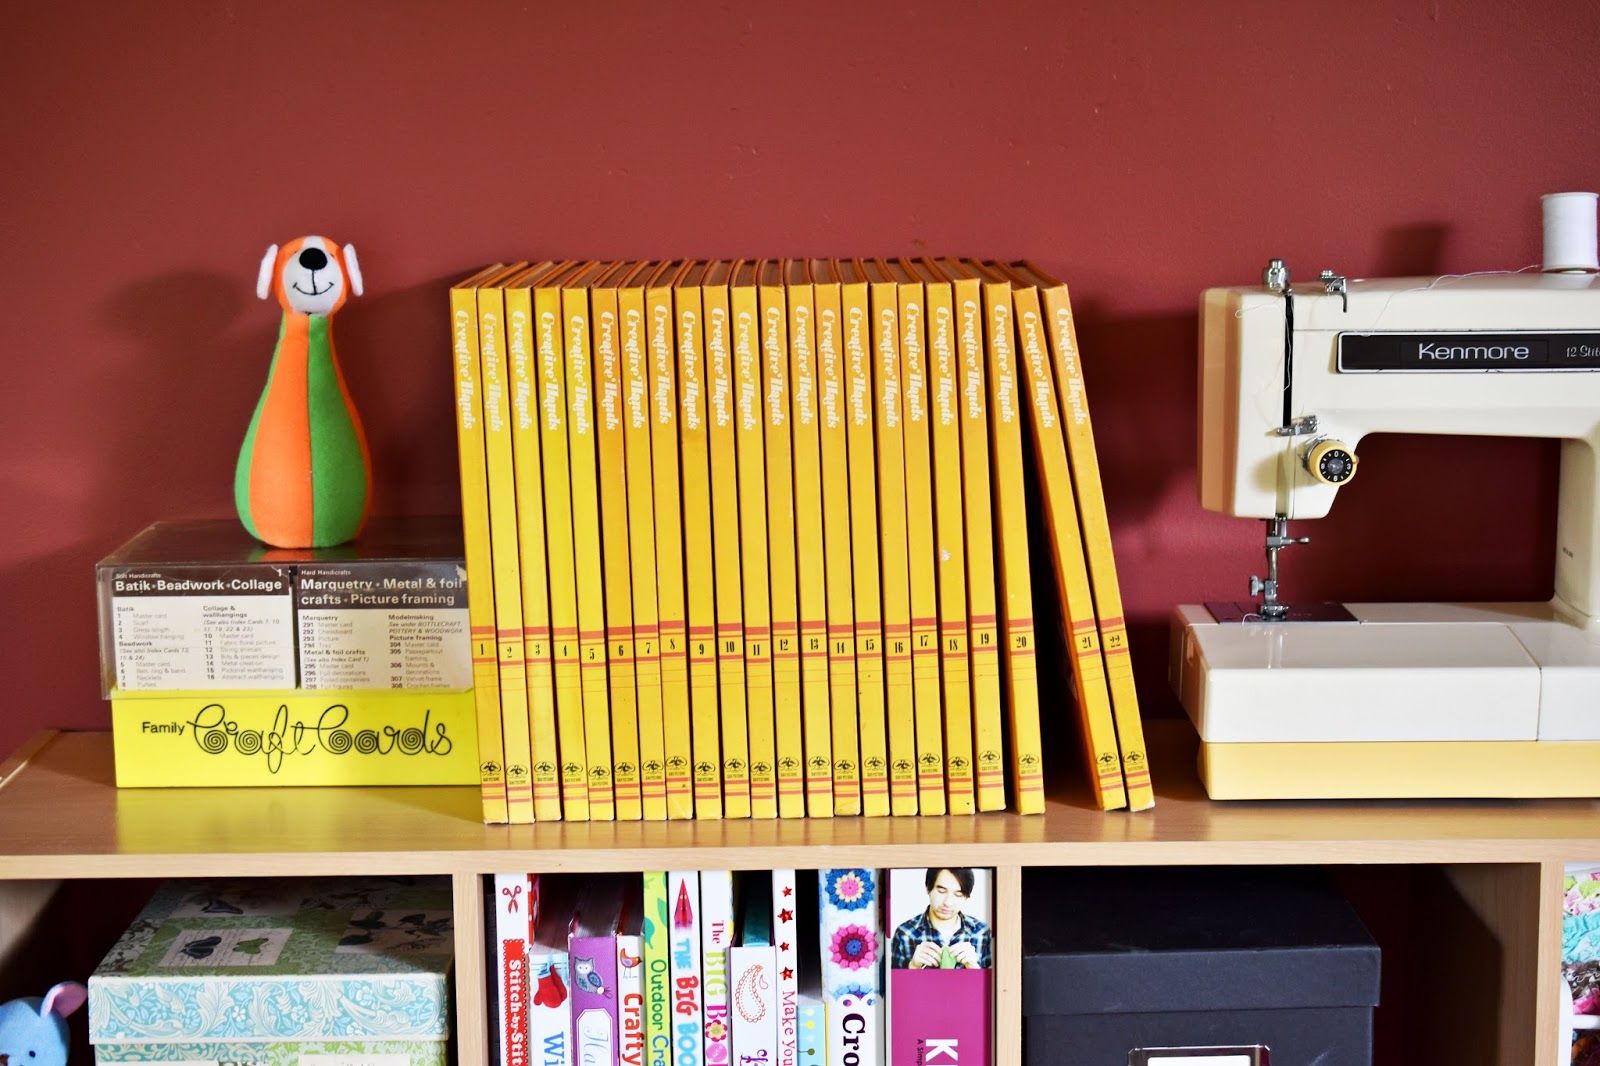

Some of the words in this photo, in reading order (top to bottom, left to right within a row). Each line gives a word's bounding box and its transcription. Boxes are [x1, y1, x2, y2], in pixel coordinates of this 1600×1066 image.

[1418, 342, 1529, 360] Kenmore
[1566, 346, 1576, 358] 12
[1580, 344, 1600, 357] Stit
[459, 376, 475, 428] Hands
[486, 379, 503, 432] Hands
[515, 376, 532, 429] Hands
[544, 378, 560, 430] Hands
[573, 382, 589, 434] Hands
[602, 378, 618, 430] Hands
[628, 376, 645, 428] Hands
[656, 371, 671, 423] Hands
[684, 377, 700, 429] Hands
[713, 374, 729, 426] Hands
[740, 378, 756, 430] Hands
[768, 374, 784, 424] Hands
[796, 372, 813, 424] Hands
[823, 376, 839, 428] Hands
[851, 374, 867, 424] Hands
[882, 375, 899, 427] Hands
[907, 369, 923, 421] Hands
[937, 373, 954, 424] Hands
[965, 366, 982, 418] Hands
[998, 370, 1014, 422] Hands
[1036, 378, 1054, 428] Hands
[1067, 374, 1086, 424] Hands
[115, 580, 150, 591] Batik
[157, 580, 224, 590] Beadwork
[231, 579, 282, 592] Collage
[301, 579, 372, 592] Marquetry
[383, 578, 422, 589] Metal
[426, 578, 436, 589] &
[440, 578, 462, 589] foil
[301, 594, 341, 605] crafts
[351, 594, 399, 604] Picture
[402, 593, 455, 606] framing
[480, 643, 484, 655] 1
[506, 646, 512, 658] 2
[535, 644, 540, 654] 3
[562, 645, 567, 657] 4
[589, 648, 595, 660] 5
[618, 644, 624, 656] 6
[646, 642, 651, 654] 7
[670, 638, 676, 650] 8
[698, 643, 704, 655] 9
[726, 641, 735, 653] 10
[753, 644, 760, 656] 11
[780, 639, 788, 651] 12
[810, 638, 819, 650] 13
[836, 642, 845, 654] 14
[865, 639, 874, 651] 15
[894, 641, 904, 654] 16
[920, 634, 928, 647] 17
[949, 639, 958, 651] 18
[980, 633, 990, 645] 19
[1016, 636, 1027, 648] 20
[1082, 636, 1091, 649] 21
[1110, 635, 1120, 648] 22
[142, 722, 185, 735] Family
[186, 704, 316, 773] Craft
[318, 704, 452, 755] Cards
[712, 920, 724, 944] The
[650, 959, 667, 1030] Outdoor
[706, 952, 728, 996] BIG
[676, 976, 699, 1016] BIG
[782, 991, 796, 1035] Make
[622, 993, 644, 1066] Crafty
[842, 1013, 866, 1066] Cro
